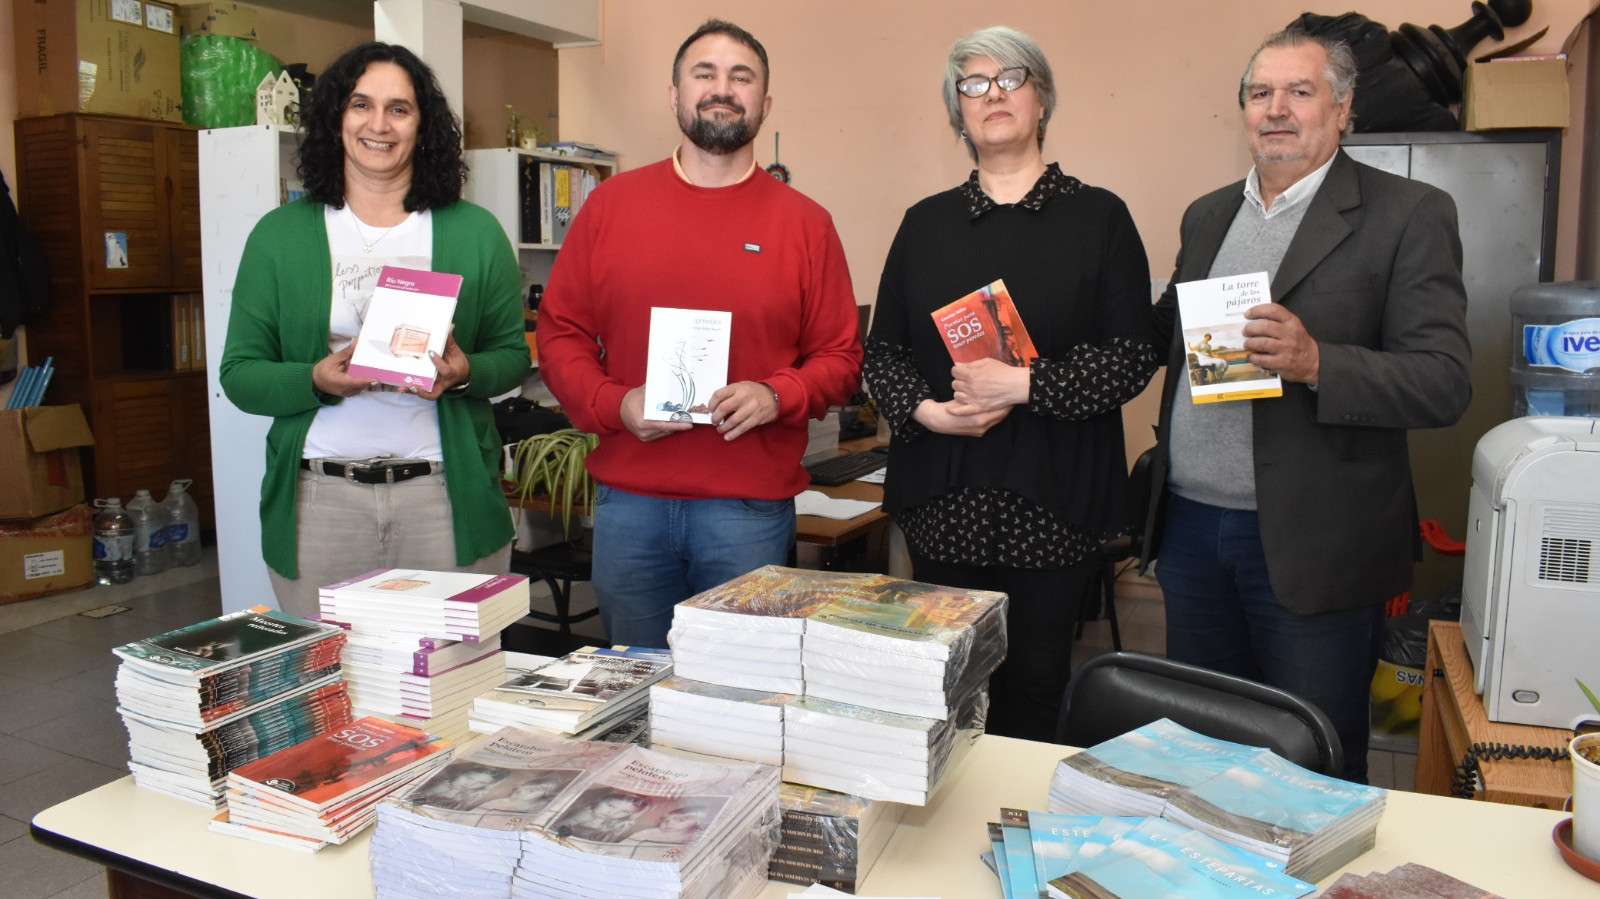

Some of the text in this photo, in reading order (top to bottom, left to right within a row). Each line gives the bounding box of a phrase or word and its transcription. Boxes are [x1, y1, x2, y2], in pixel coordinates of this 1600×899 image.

[37, 28, 47, 74] FRAGIL
[335, 262, 360, 277] less
[396, 278, 415, 287] Negro
[1222, 280, 1259, 291] La torre
[1226, 297, 1261, 309] pájaros
[947, 317, 982, 344] SOS
[333, 729, 384, 748] SOS
[498, 736, 552, 753] Escarabajo
[489, 742, 533, 756] pelotero
[624, 764, 670, 781] pelotero
[631, 760, 688, 778] Escarabajo
[1180, 846, 1275, 895] ESTEPARIAS
